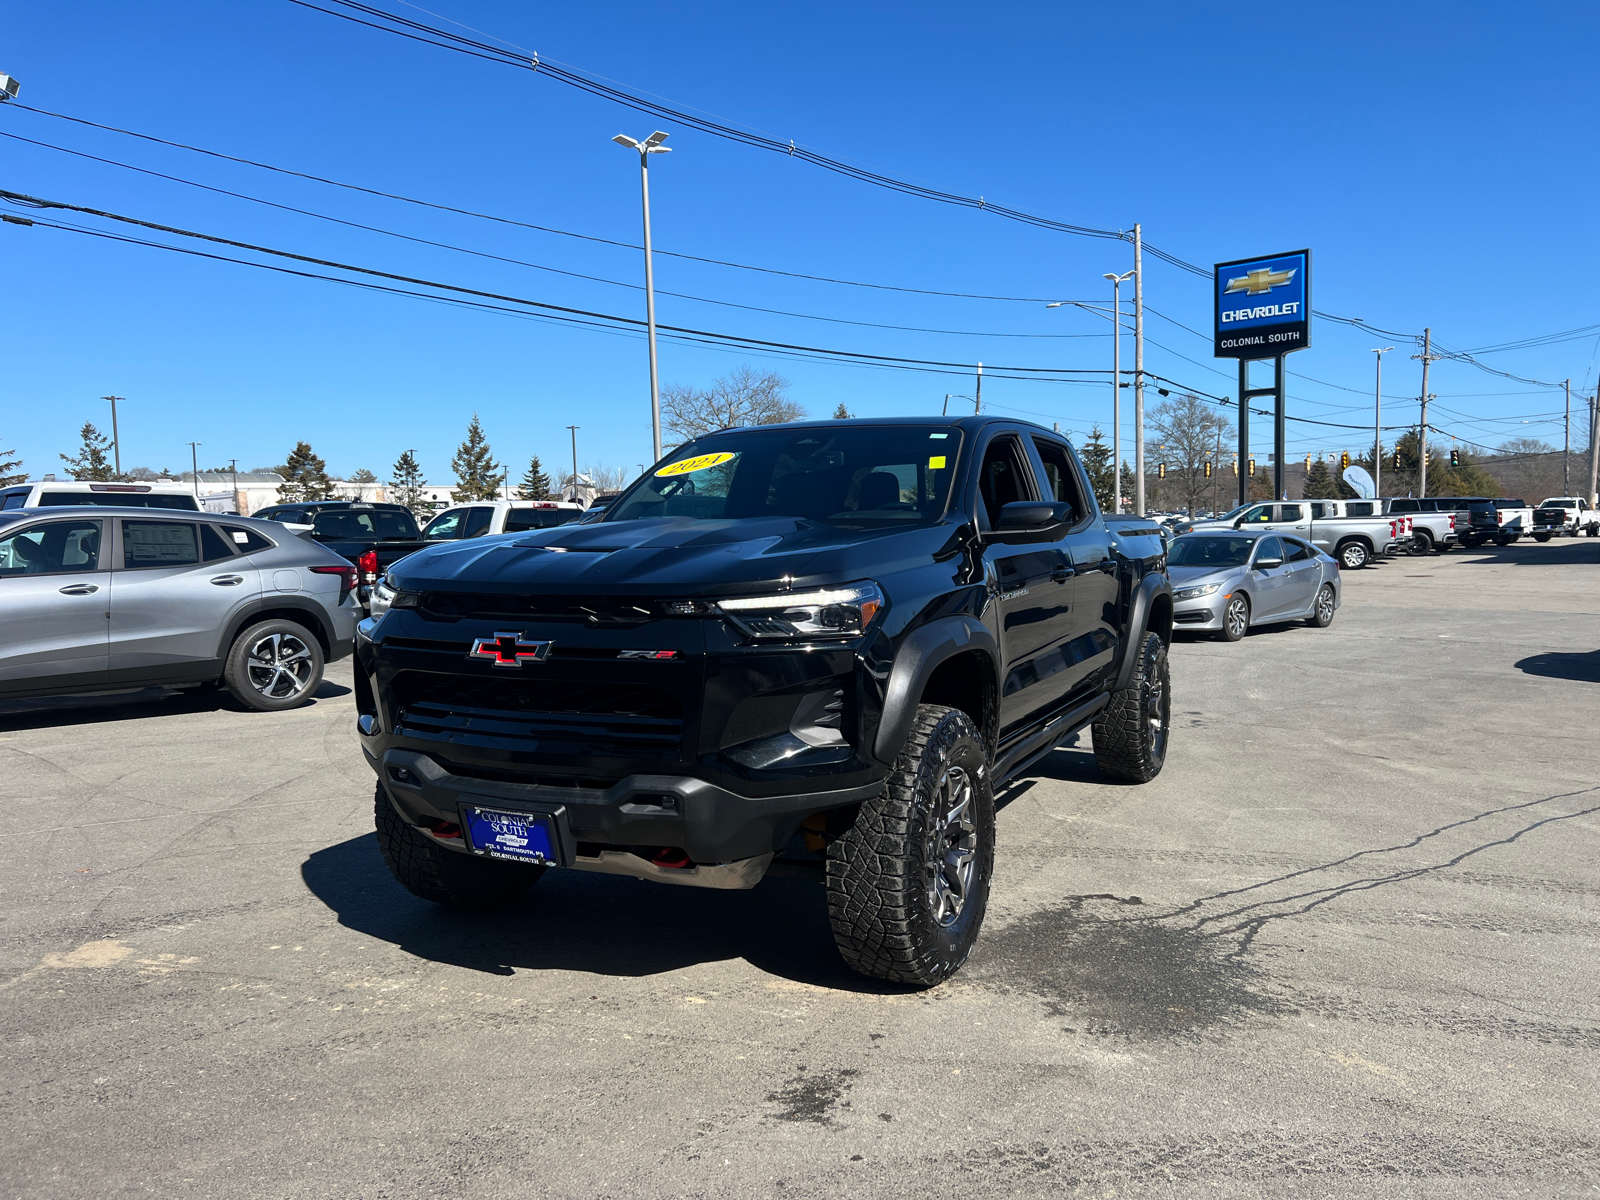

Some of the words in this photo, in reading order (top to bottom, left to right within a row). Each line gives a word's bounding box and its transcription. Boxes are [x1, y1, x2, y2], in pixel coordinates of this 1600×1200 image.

[1222, 302, 1299, 322] CHEVROLET
[1221, 336, 1265, 348] COLONIAL
[1268, 331, 1300, 343] SOUTH
[667, 454, 722, 474] 2024
[617, 650, 677, 659] ZR2
[482, 813, 534, 827] COLONIAL
[491, 822, 528, 836] SOUTH
[498, 836, 525, 844] CHEVROLET
[491, 852, 519, 860] COLONIAL
